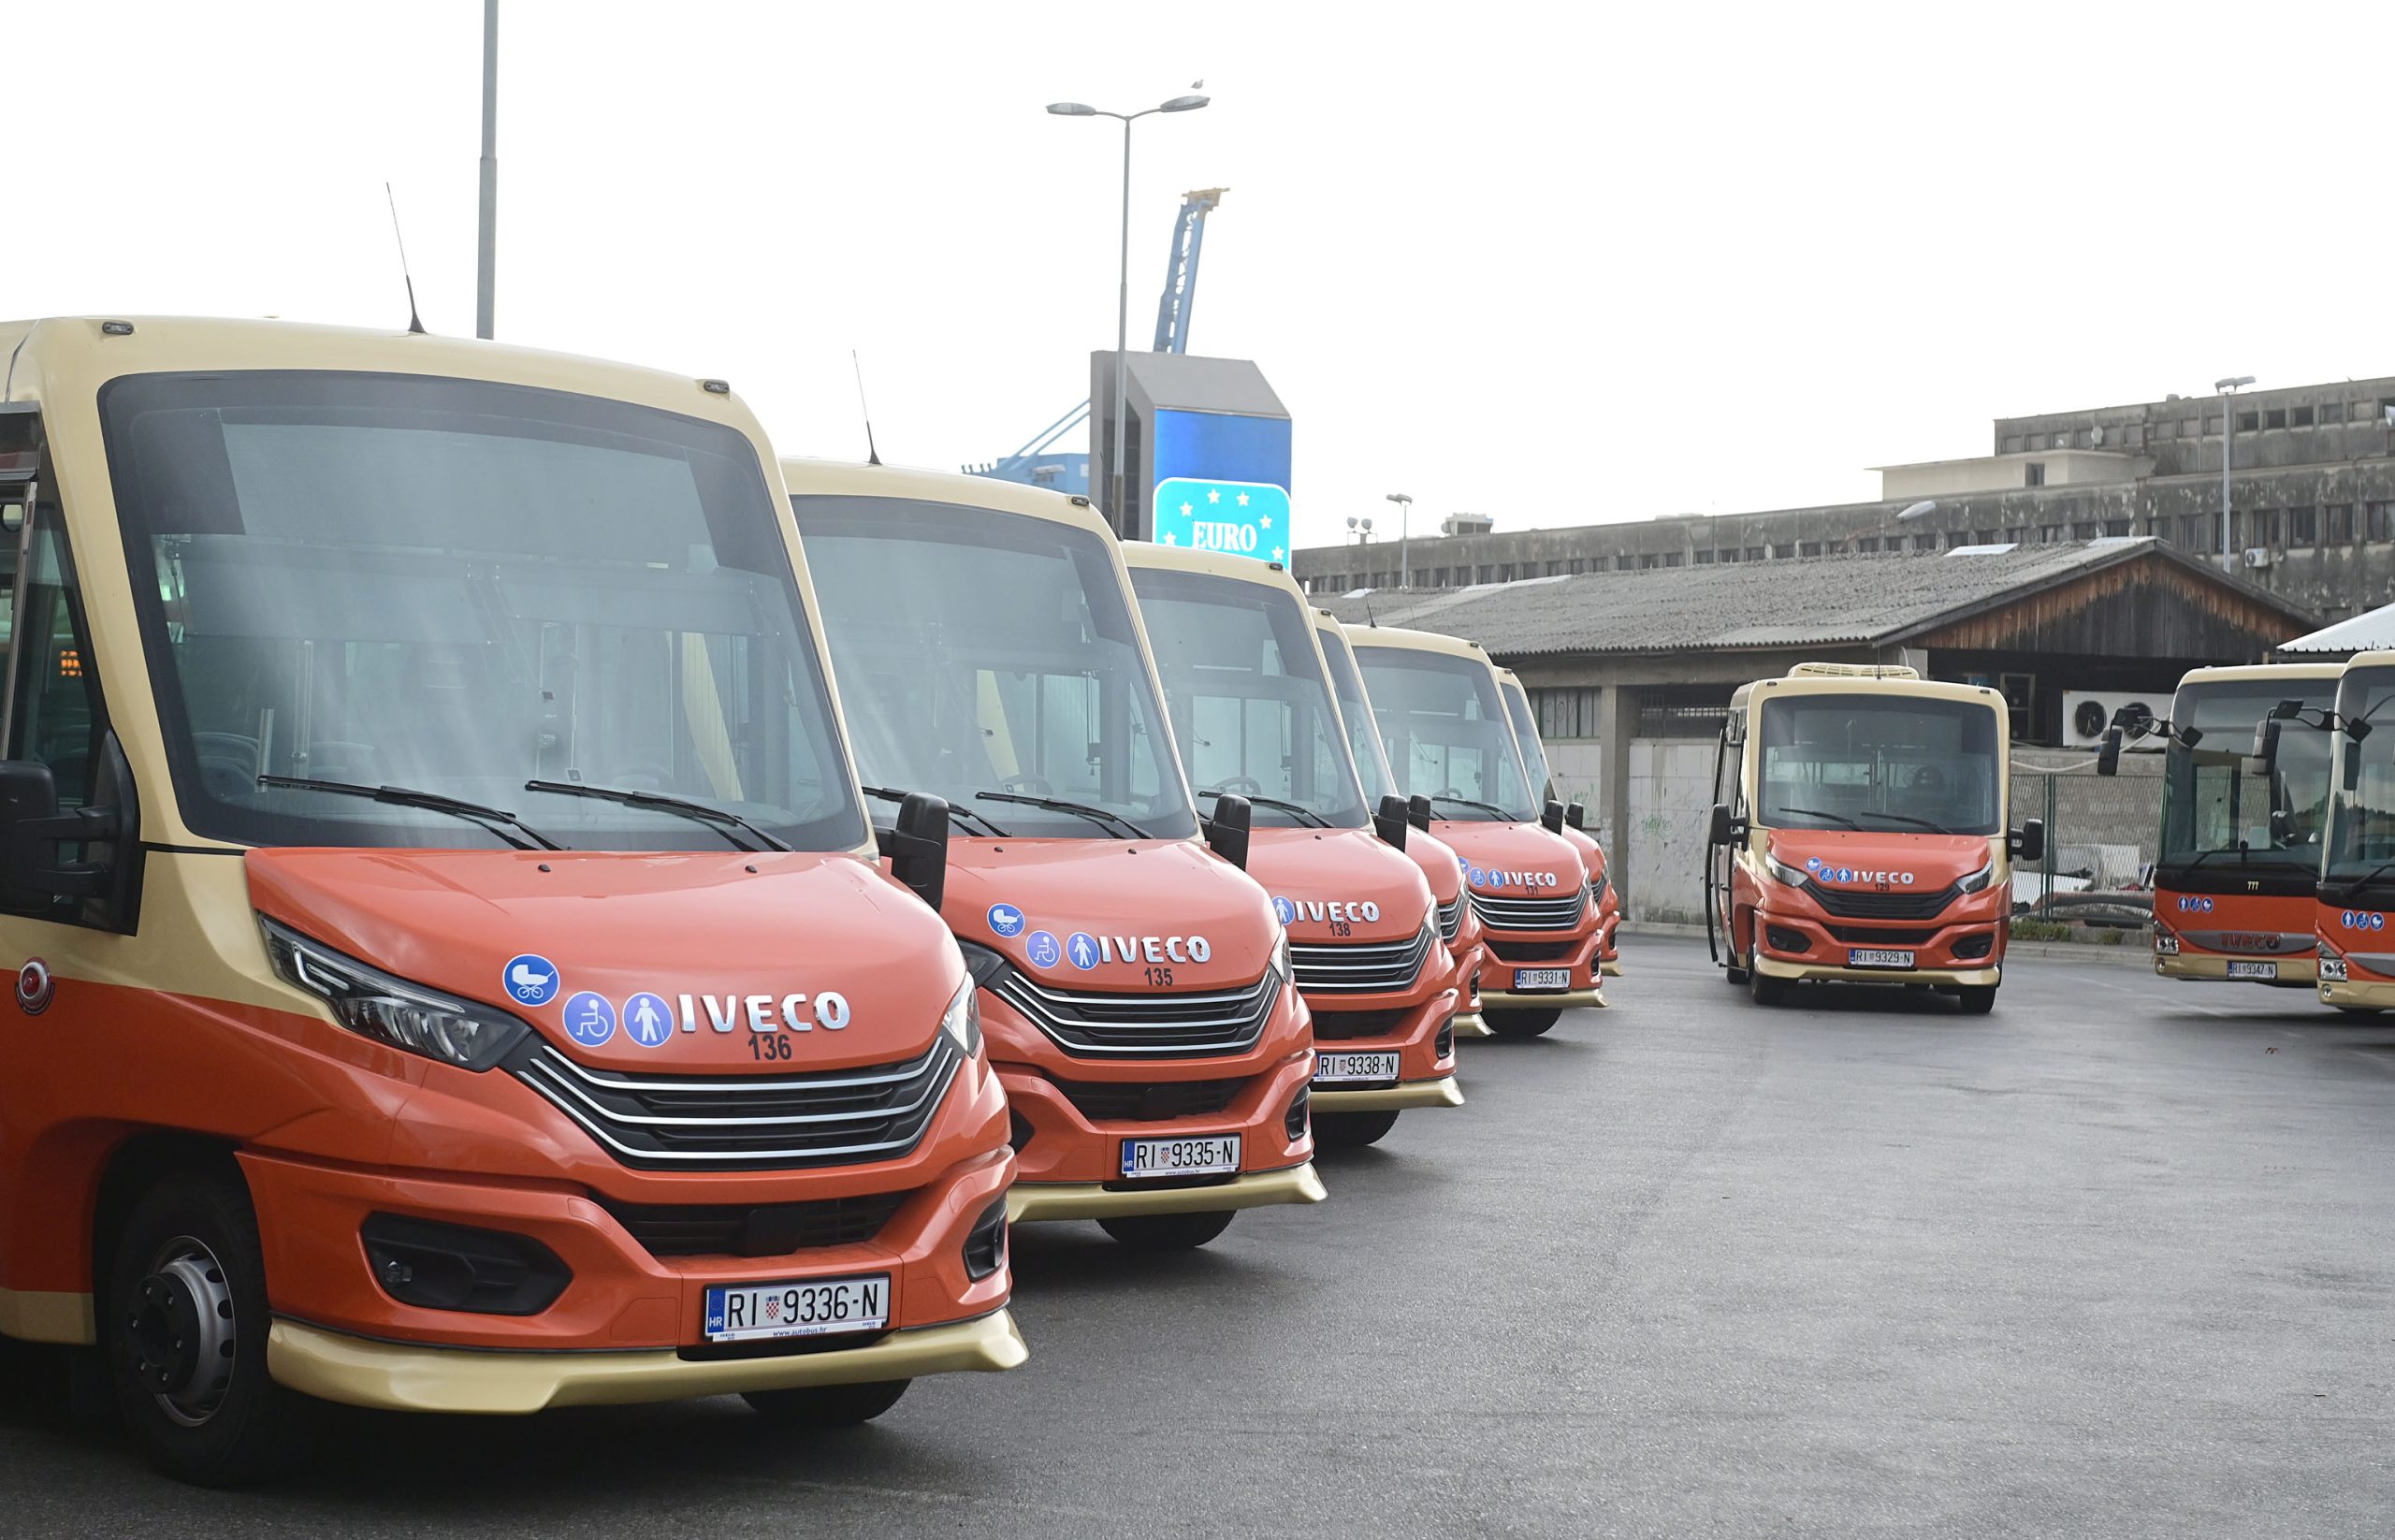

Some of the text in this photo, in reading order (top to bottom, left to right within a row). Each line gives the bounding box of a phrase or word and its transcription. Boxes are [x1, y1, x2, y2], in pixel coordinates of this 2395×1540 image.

[1192, 520, 1257, 552] EURO
[1503, 871, 1557, 887] IVECO
[1852, 870, 1914, 884] IVECO
[2247, 880, 2259, 891] 777
[1294, 900, 1380, 923] IVECO
[1328, 922, 1351, 937] 138
[1097, 936, 1211, 964] IVECO
[2221, 933, 2281, 950] IVECO
[1856, 951, 1910, 964] RI 9329-N
[1144, 967, 1173, 987] 135
[1521, 971, 1567, 984] RI 9331-N
[678, 992, 850, 1033] IVECO
[748, 1034, 792, 1060] 136
[1321, 1055, 1394, 1075] RI 9338-N
[1136, 1140, 1233, 1168] RI 9335-N
[728, 1283, 878, 1328] RI 9336-N
[709, 1316, 723, 1327] HR
[773, 1326, 828, 1338] www.autobus.hr
